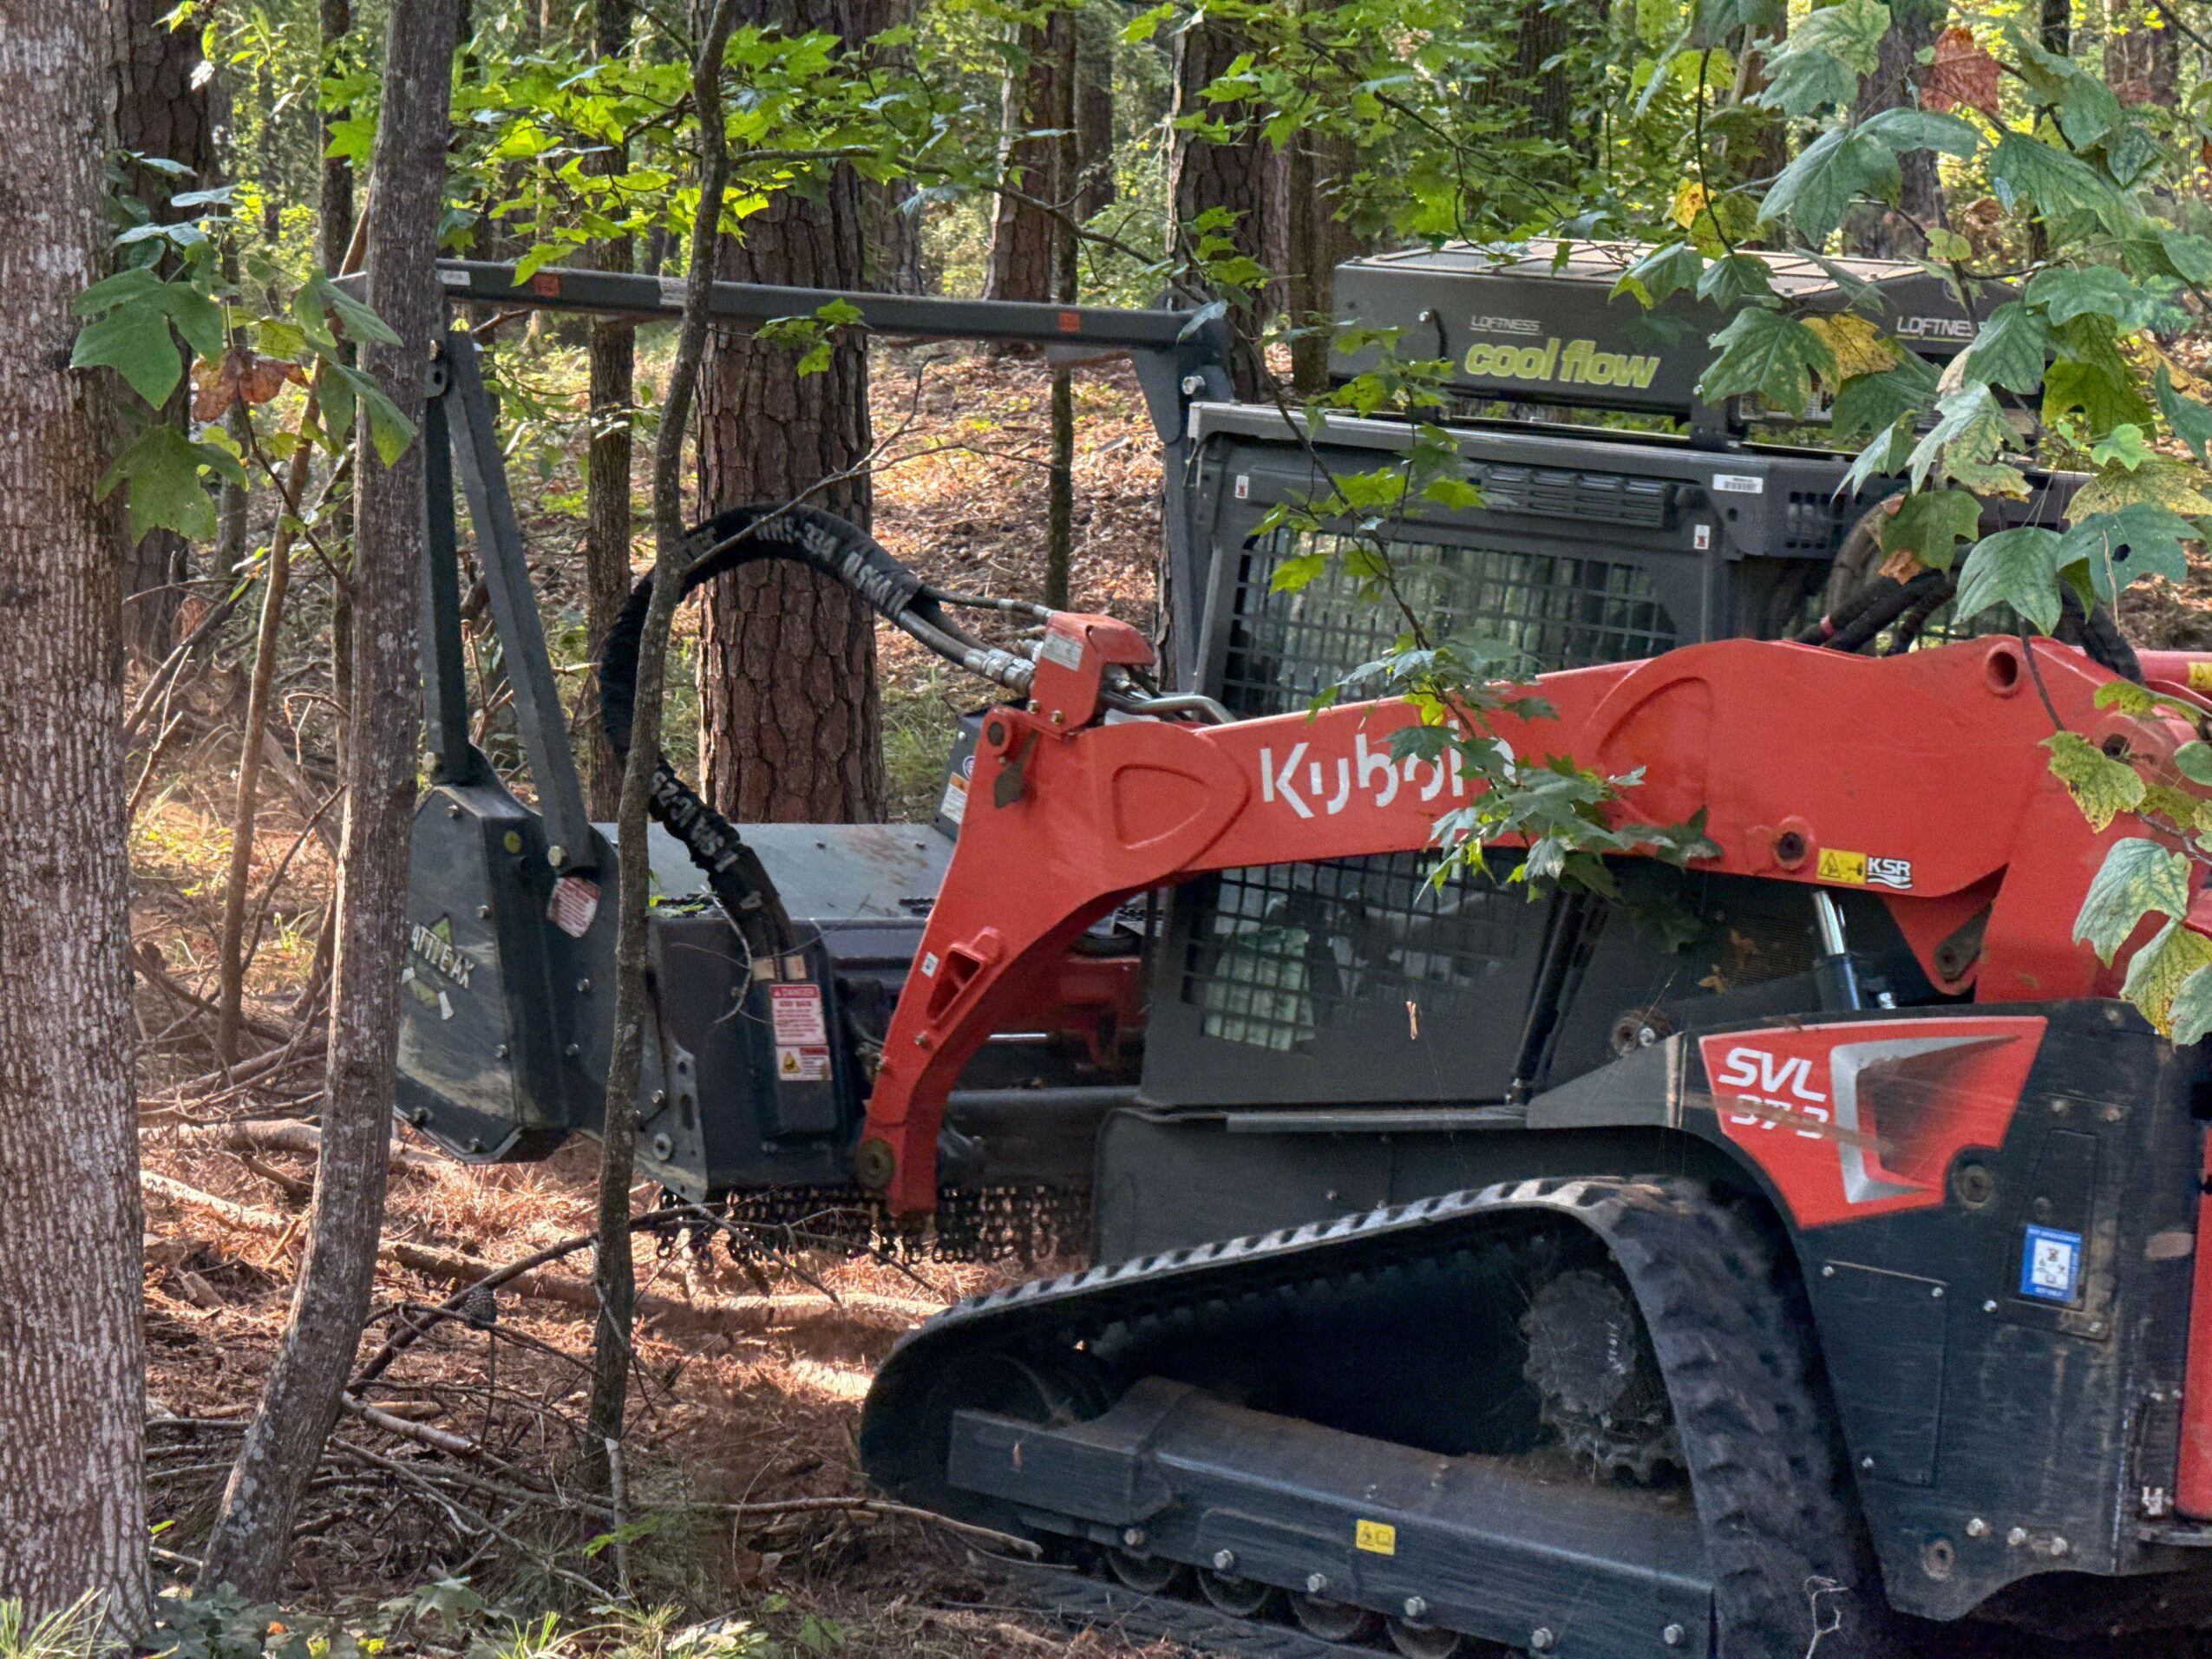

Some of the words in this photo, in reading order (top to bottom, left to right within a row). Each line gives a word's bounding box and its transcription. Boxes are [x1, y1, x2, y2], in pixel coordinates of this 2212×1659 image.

[1471, 316, 1541, 331] LOFTNESS
[1465, 337, 1561, 381] cool
[1559, 339, 1660, 389] flow
[1868, 857, 1911, 877] KSR
[1718, 1047, 1827, 1102] SVL
